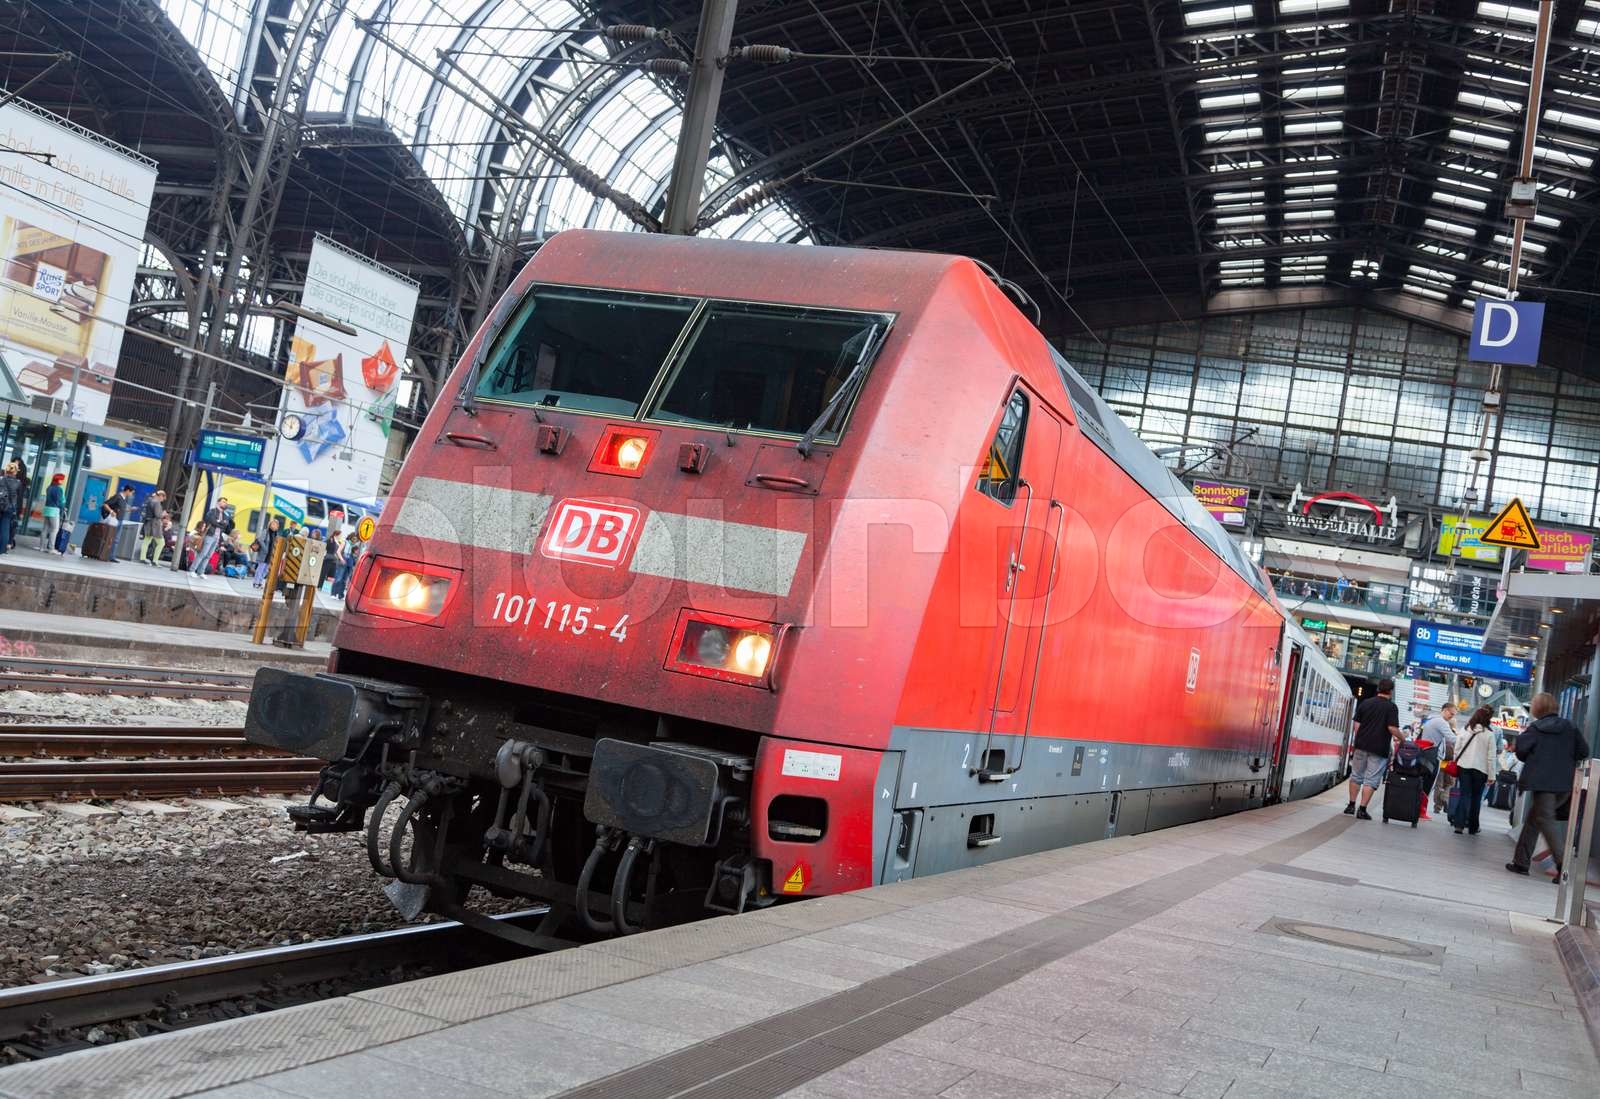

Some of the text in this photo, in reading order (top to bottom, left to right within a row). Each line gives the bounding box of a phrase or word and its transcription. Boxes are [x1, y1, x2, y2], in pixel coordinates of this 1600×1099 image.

[35, 283, 60, 297] SPORT
[1480, 302, 1519, 347] D
[1193, 485, 1249, 498] Sonntags-
[556, 508, 625, 556] DB
[1287, 514, 1397, 541] WANDELHALLE
[1538, 530, 1573, 544] risch
[492, 592, 630, 643] 101 115-4
[1416, 627, 1431, 640] 8b
[1434, 652, 1472, 664] Passau Hbf
[1406, 666, 1414, 677] E
[961, 744, 970, 769] 2
